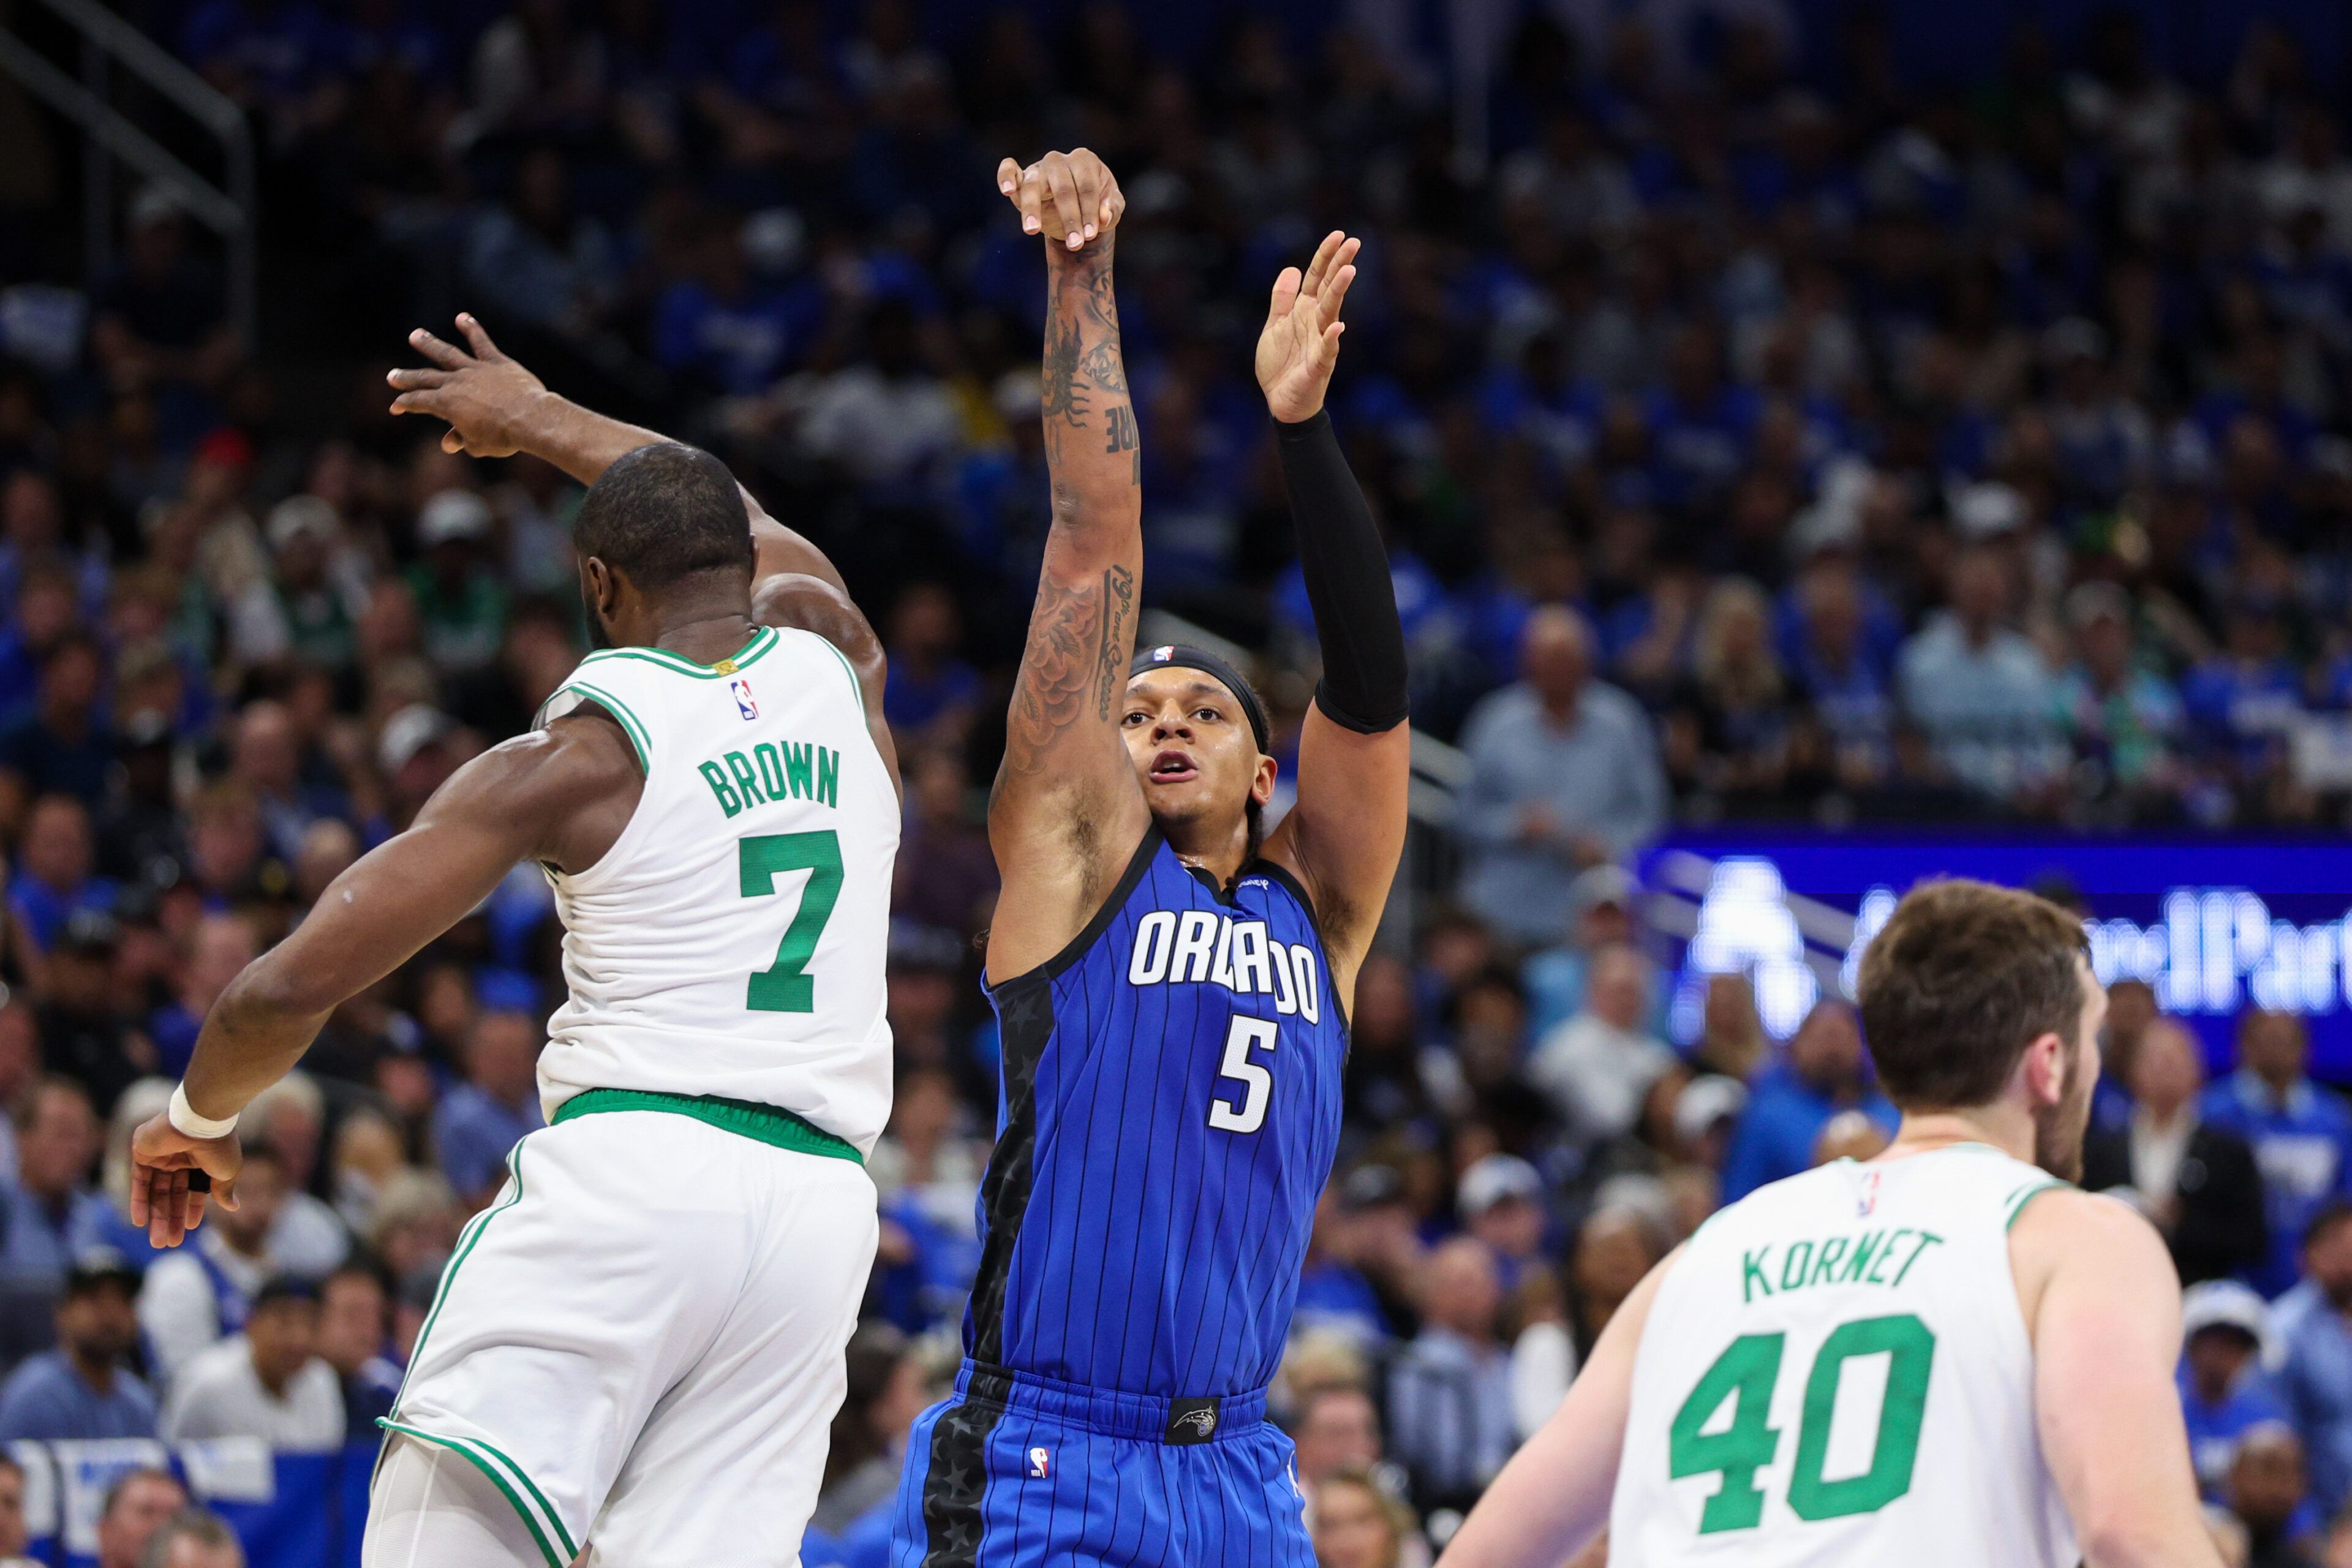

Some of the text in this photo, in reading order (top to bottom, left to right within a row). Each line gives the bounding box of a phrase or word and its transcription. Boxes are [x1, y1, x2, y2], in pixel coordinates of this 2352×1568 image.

[697, 739, 840, 819] BROWN
[739, 829, 844, 1012] 7
[1128, 910, 1319, 1026] ORLADO
[1207, 1013, 1279, 1134] 5
[1742, 1227, 1945, 1304] KORNET
[1668, 1312, 1937, 1535] 40
